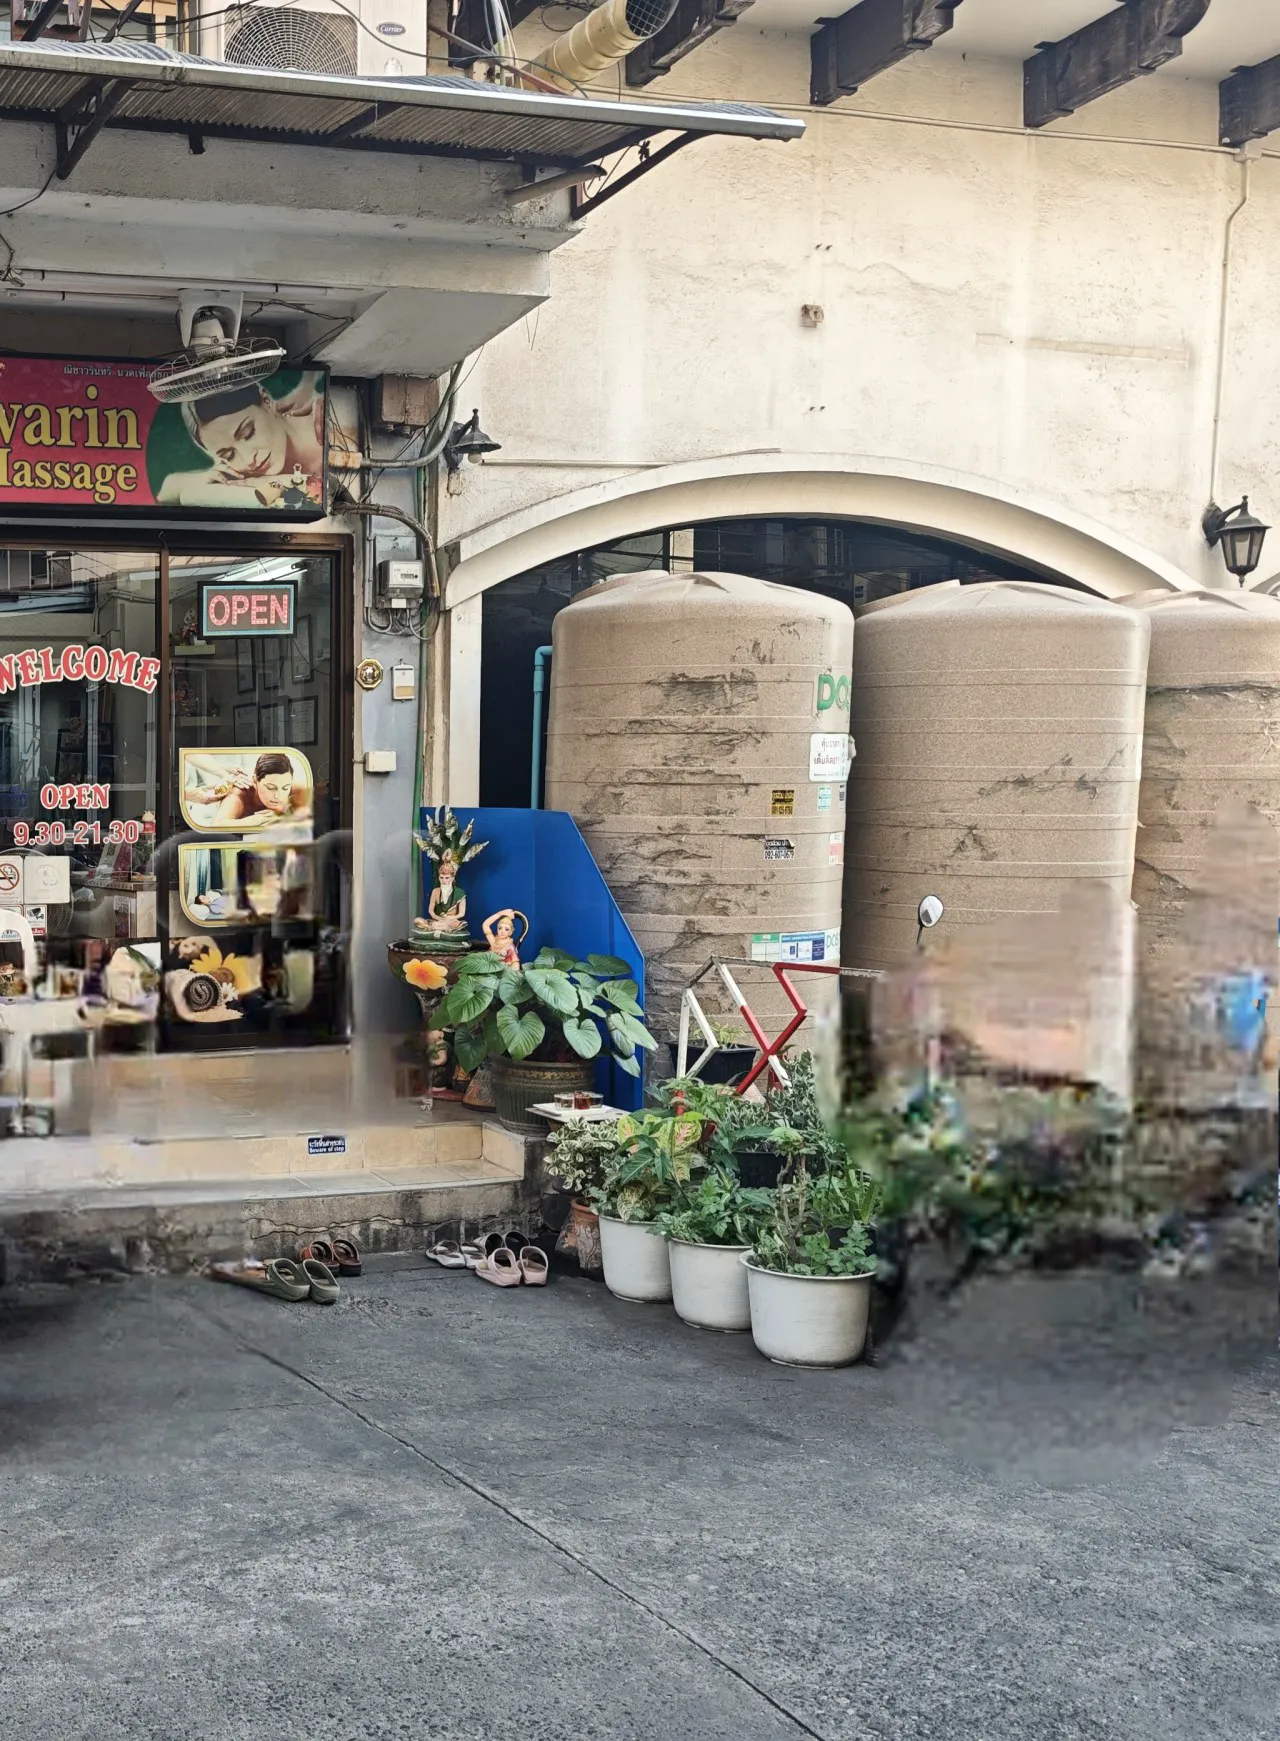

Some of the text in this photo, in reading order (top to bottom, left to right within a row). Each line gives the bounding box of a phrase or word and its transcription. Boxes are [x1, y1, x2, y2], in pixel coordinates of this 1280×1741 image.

[208, 594, 289, 626] OPEN
[40, 782, 111, 810] OPEN
[13, 820, 139, 846] 9.30-21.30
